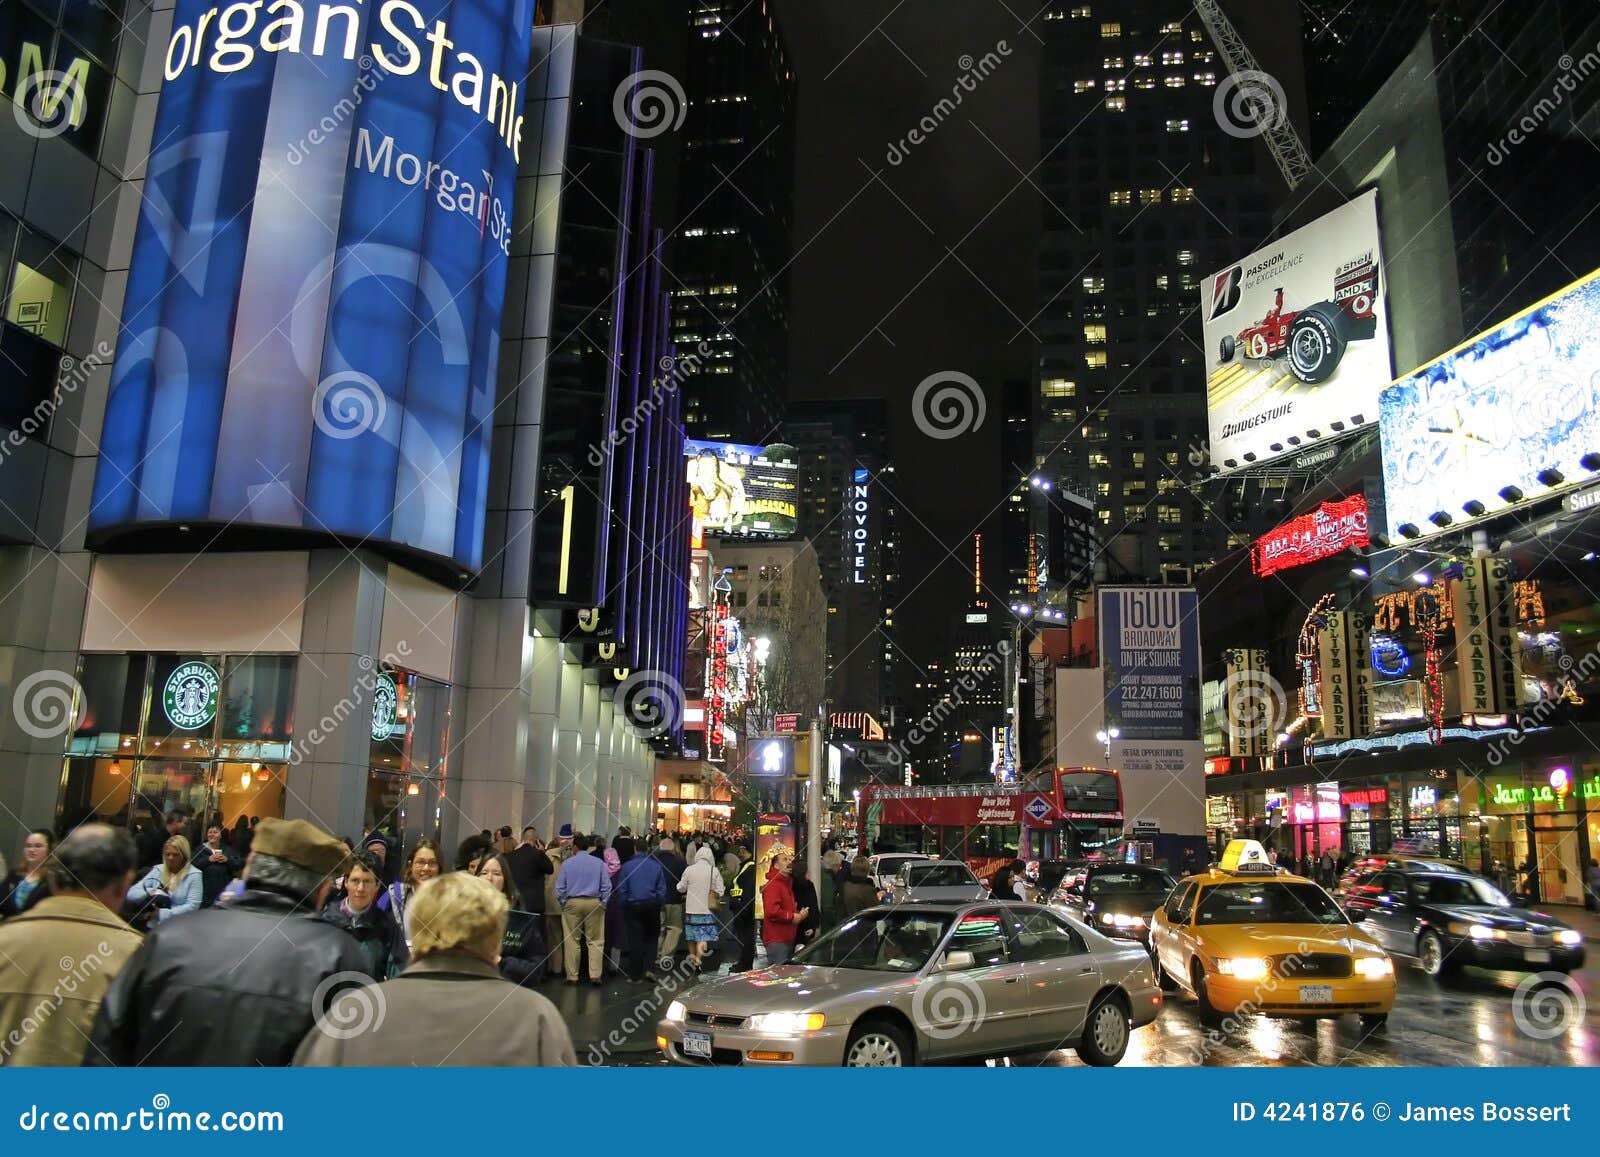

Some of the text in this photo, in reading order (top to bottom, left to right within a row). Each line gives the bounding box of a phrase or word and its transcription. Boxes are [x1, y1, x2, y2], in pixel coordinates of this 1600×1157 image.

[1246, 252, 1285, 279] PASSION
[1256, 253, 1305, 285] EXCELLENCE
[1337, 282, 1361, 300] AMD
[1221, 401, 1294, 440] BRIDGESTONE
[1296, 448, 1335, 469] SHERWOOD
[854, 485, 868, 584] NOVOTEL
[1123, 591, 1177, 628] 1600
[1124, 630, 1177, 647] BROADWAY
[1464, 566, 1487, 710] OLIVE GARDEN
[1120, 651, 1182, 667] ON THE SQUARE
[168, 665, 219, 693] STARBUCKS
[1328, 618, 1345, 736] OLIVE GARDEN
[1121, 686, 1183, 700] 212.247.1600
[170, 708, 209, 726] COFFEE
[981, 796, 1011, 806] New York
[977, 808, 1016, 821] Sightseeing
